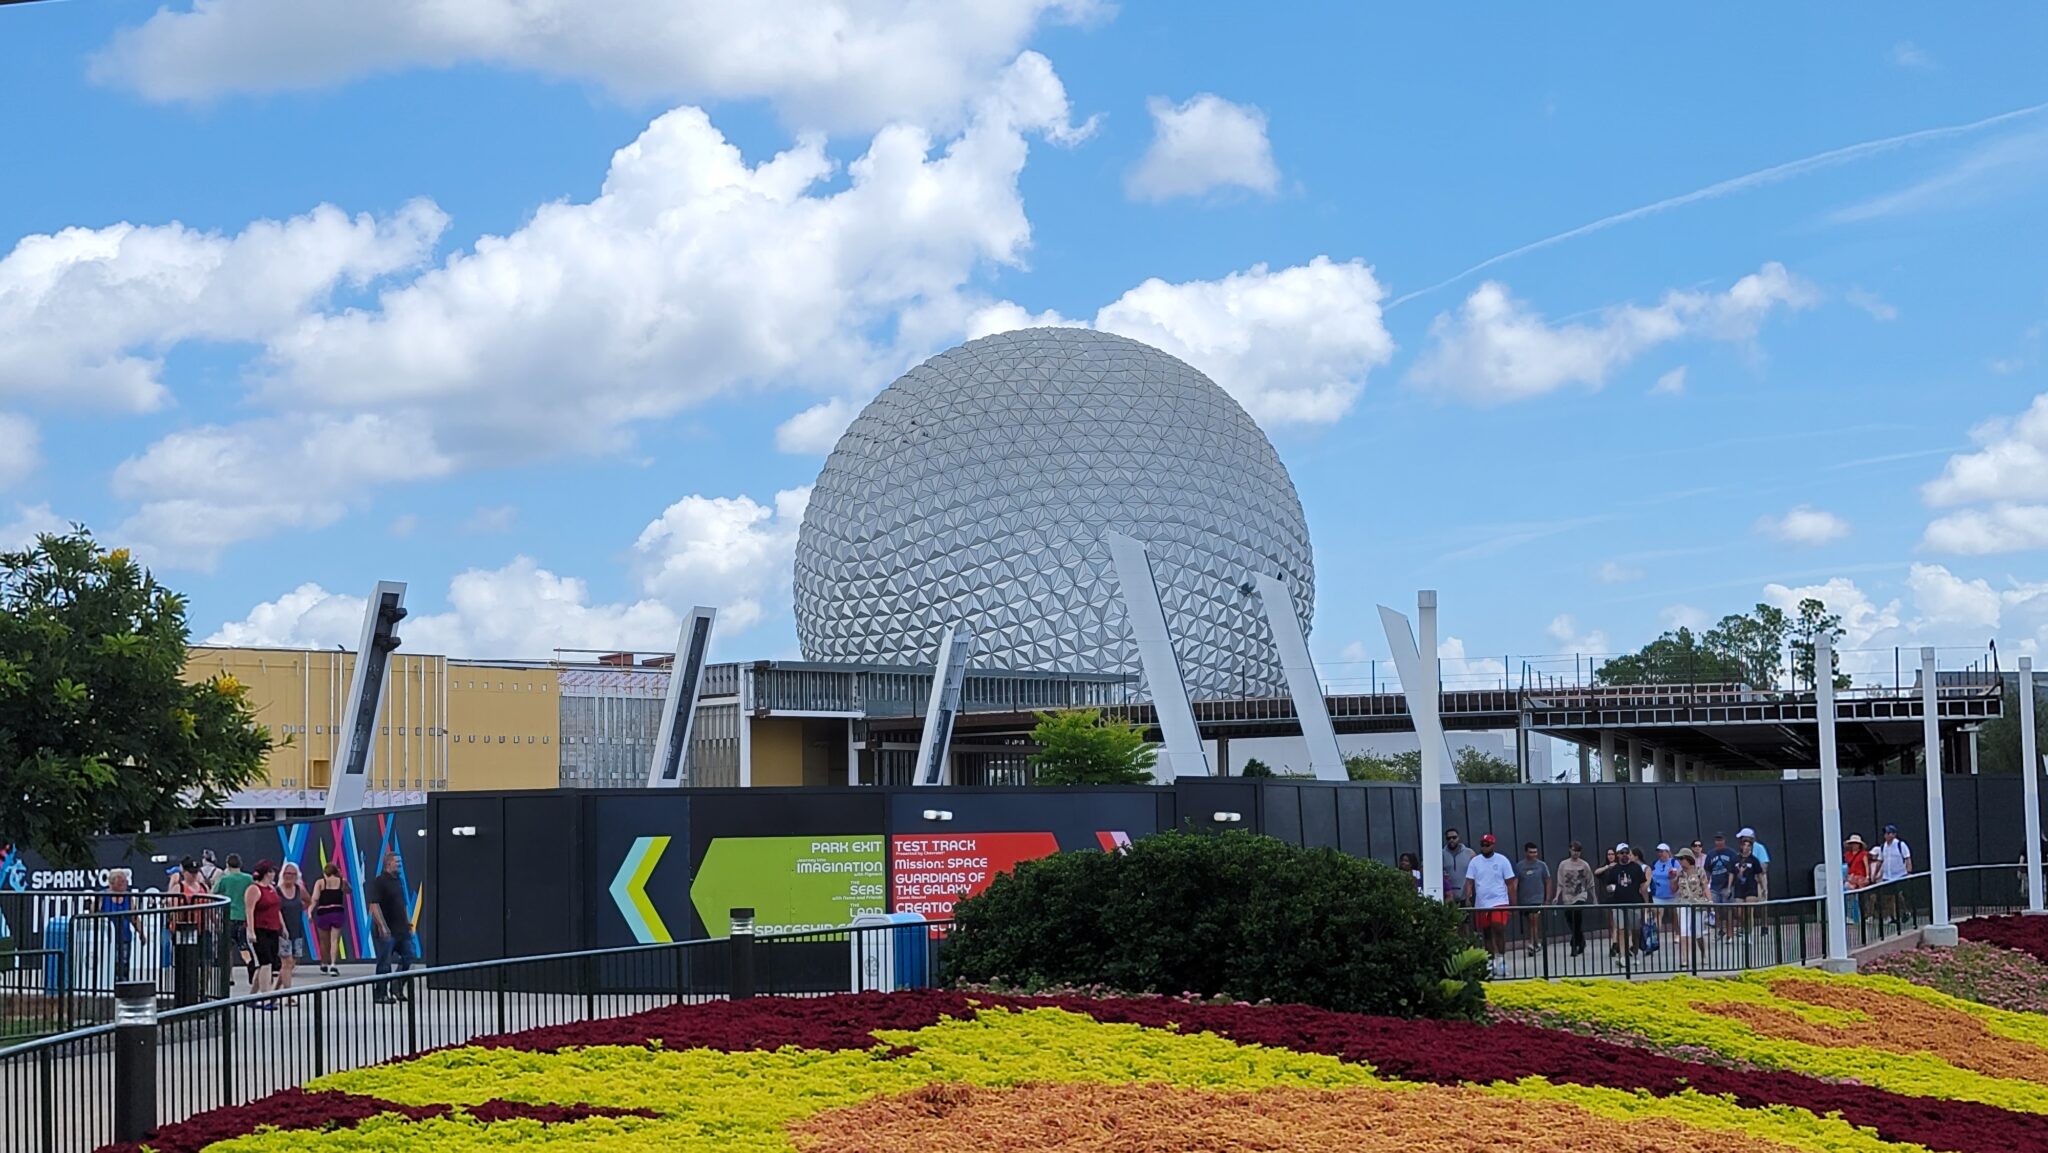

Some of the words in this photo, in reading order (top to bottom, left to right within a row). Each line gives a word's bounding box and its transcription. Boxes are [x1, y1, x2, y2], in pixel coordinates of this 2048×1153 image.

[811, 841, 849, 854] PARK
[852, 841, 882, 853] EXIT
[895, 841, 928, 852] TEST
[932, 840, 976, 851] TRACK
[797, 861, 883, 873] IMAGINATION
[895, 858, 944, 869] Mission:
[947, 858, 988, 868] SPACE
[31, 869, 84, 889] SPARK
[87, 868, 132, 888] YOR
[895, 872, 966, 884] GUARDIANS
[968, 872, 985, 883] OF
[850, 884, 883, 895] SEAS
[895, 885, 920, 895] THE
[923, 884, 972, 895] GALAXY
[895, 902, 956, 914] CREATIO
